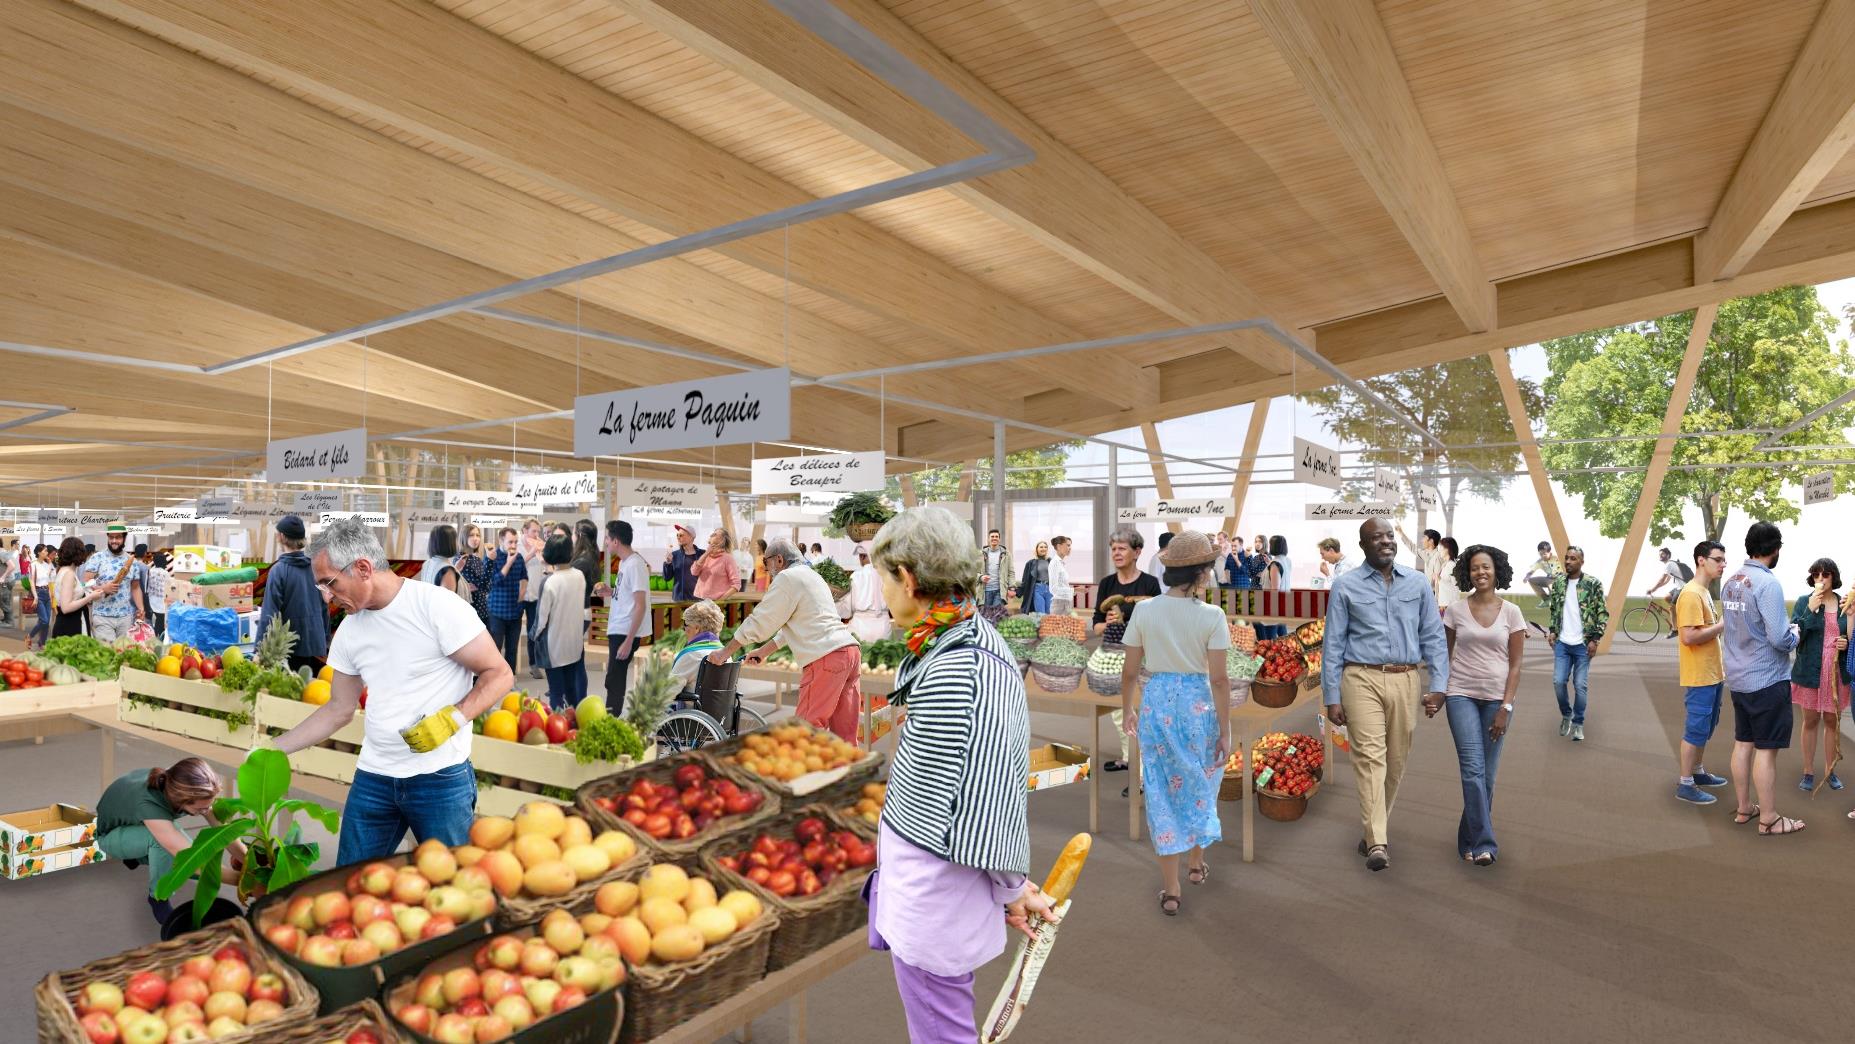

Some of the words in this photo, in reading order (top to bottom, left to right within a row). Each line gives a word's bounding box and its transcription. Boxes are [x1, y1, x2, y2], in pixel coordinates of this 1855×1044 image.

[599, 401, 624, 435] La
[630, 401, 676, 444] ferme
[684, 390, 761, 438] Paquin
[284, 448, 316, 469] Bédard
[319, 449, 328, 467] et
[331, 443, 349, 473] fils
[1302, 445, 1312, 468] La
[771, 459, 794, 471] Les
[800, 459, 841, 470] délices
[845, 458, 860, 468] de
[790, 473, 843, 487] Beaupré
[515, 483, 531, 498] Les
[533, 483, 558, 502] fruits
[560, 482, 572, 494] de
[634, 483, 648, 492] Le
[650, 485, 684, 495] potager
[687, 485, 698, 494] de
[314, 493, 338, 502] légumes
[449, 496, 460, 505] Le
[463, 499, 484, 508] verger
[487, 496, 510, 506] Blouin
[649, 496, 682, 506] Manon
[1120, 509, 1131, 518] La
[1133, 511, 1146, 519] ferm
[1157, 501, 1201, 515] Pommes
[1206, 500, 1225, 514] Inc
[1312, 505, 1326, 515] La
[1329, 505, 1353, 518] ferme
[1356, 504, 1391, 515] Lacroix
[156, 510, 191, 521] Fruiterie
[440, 514, 449, 522] de
